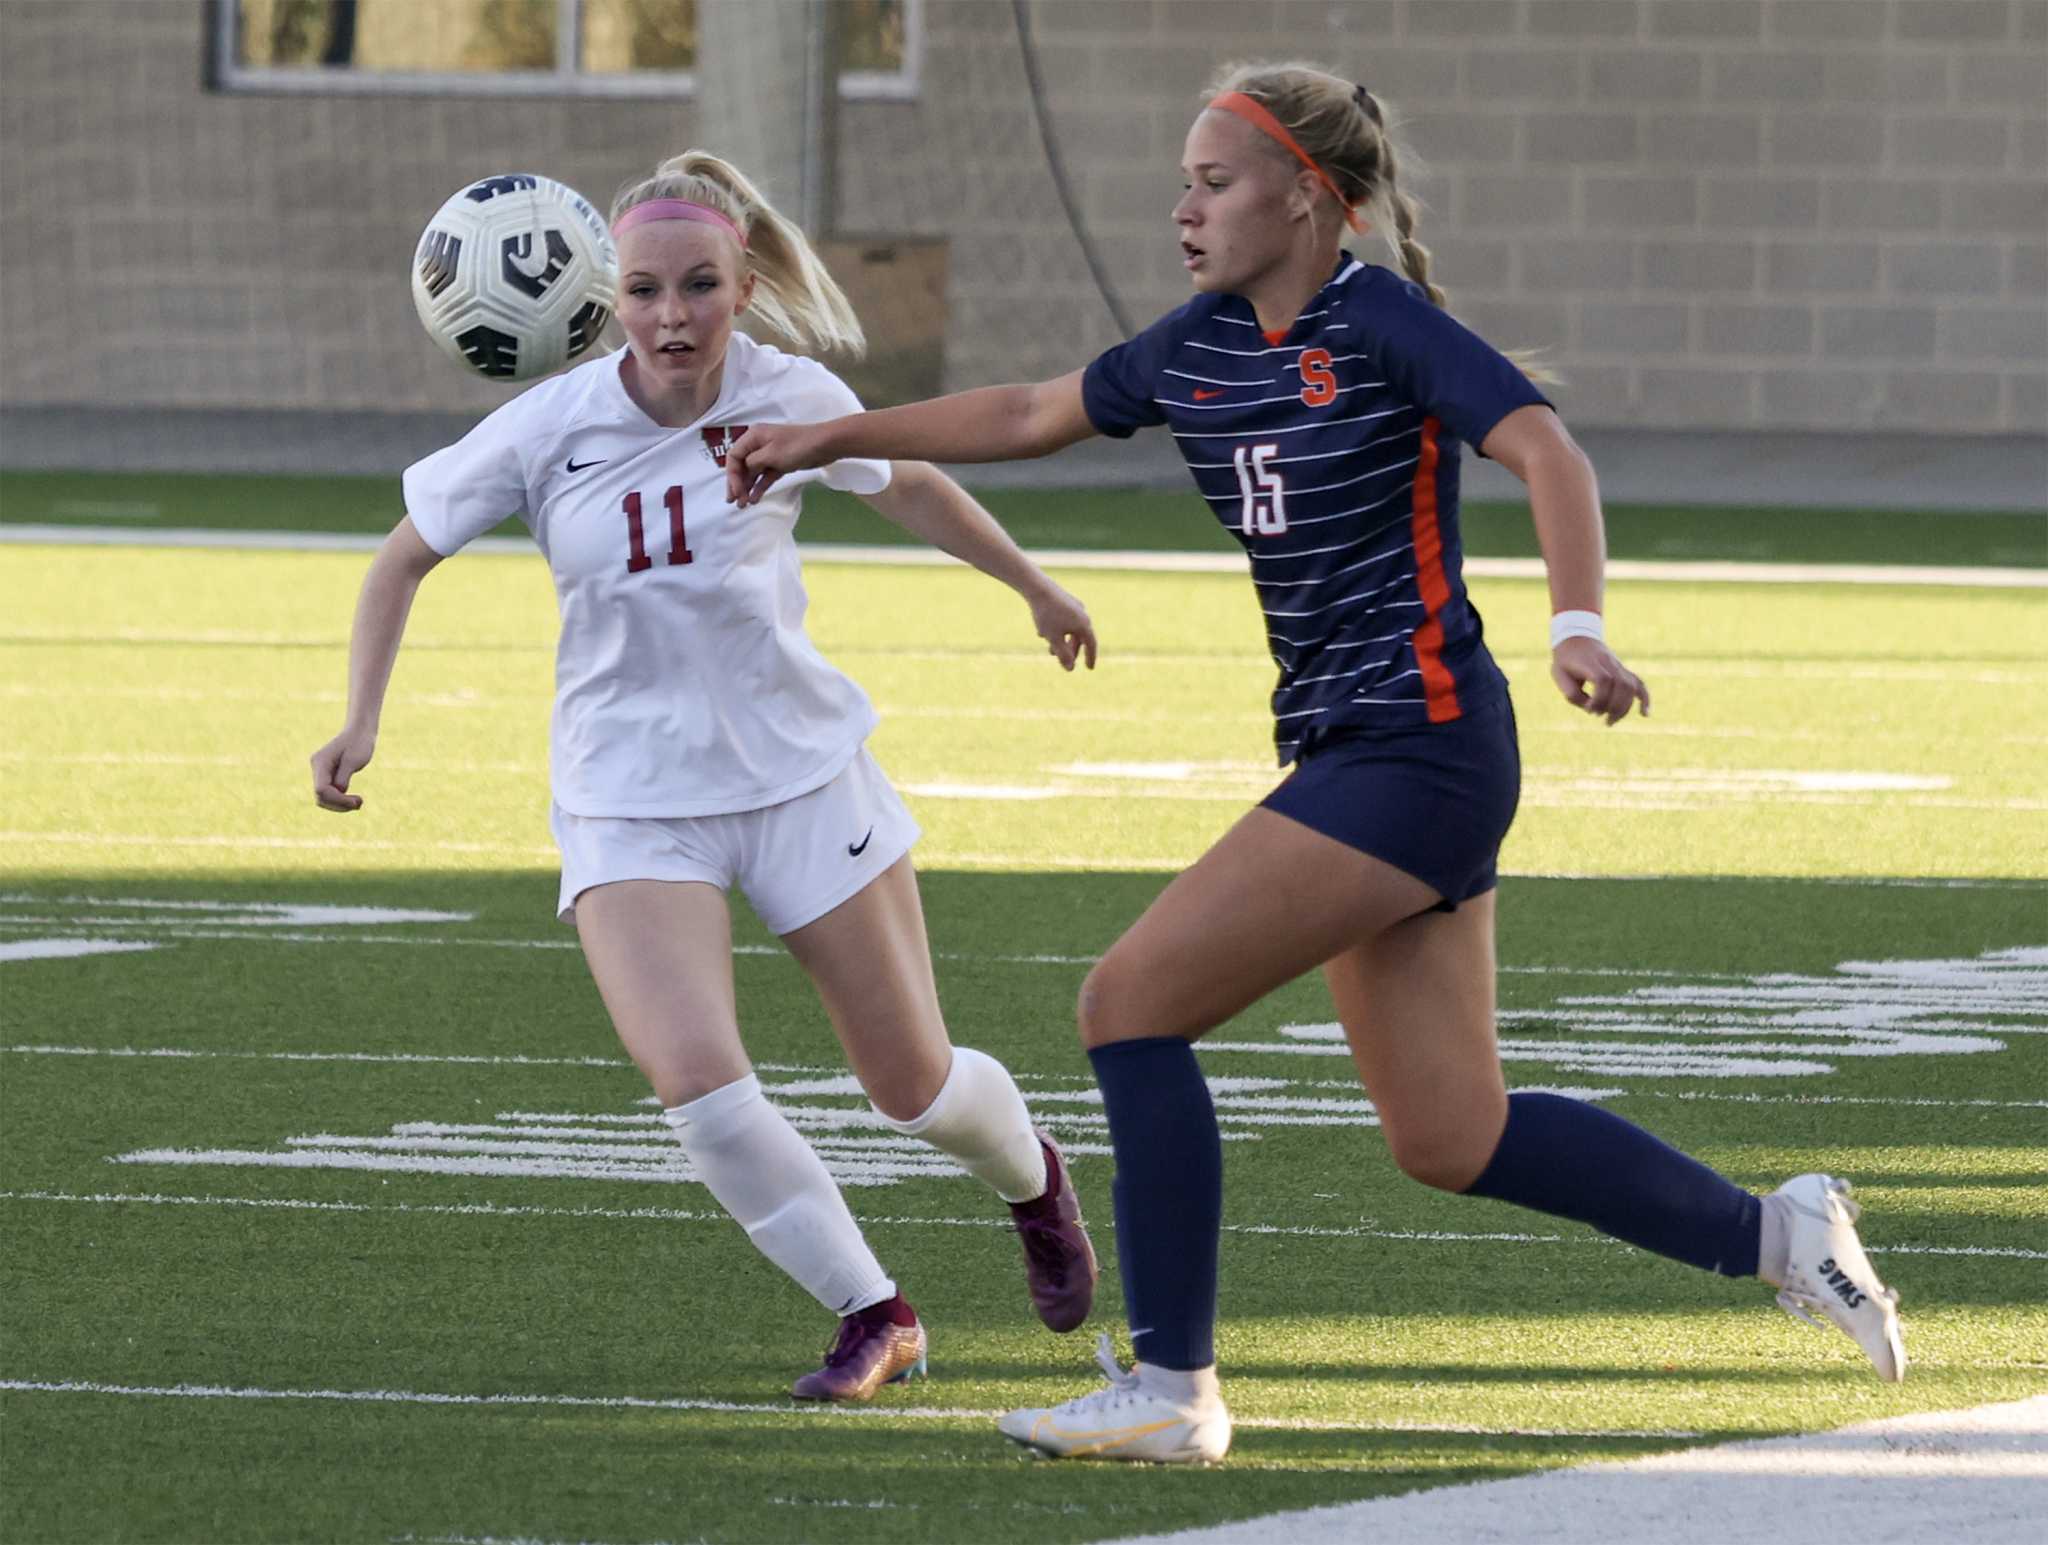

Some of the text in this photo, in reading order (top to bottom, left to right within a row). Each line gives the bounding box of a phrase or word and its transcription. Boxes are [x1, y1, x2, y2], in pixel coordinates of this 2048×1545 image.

[1299, 348, 1337, 408] S
[1234, 444, 1288, 536] 15
[622, 485, 693, 573] 11
[1818, 1258, 1867, 1309] SWAG
